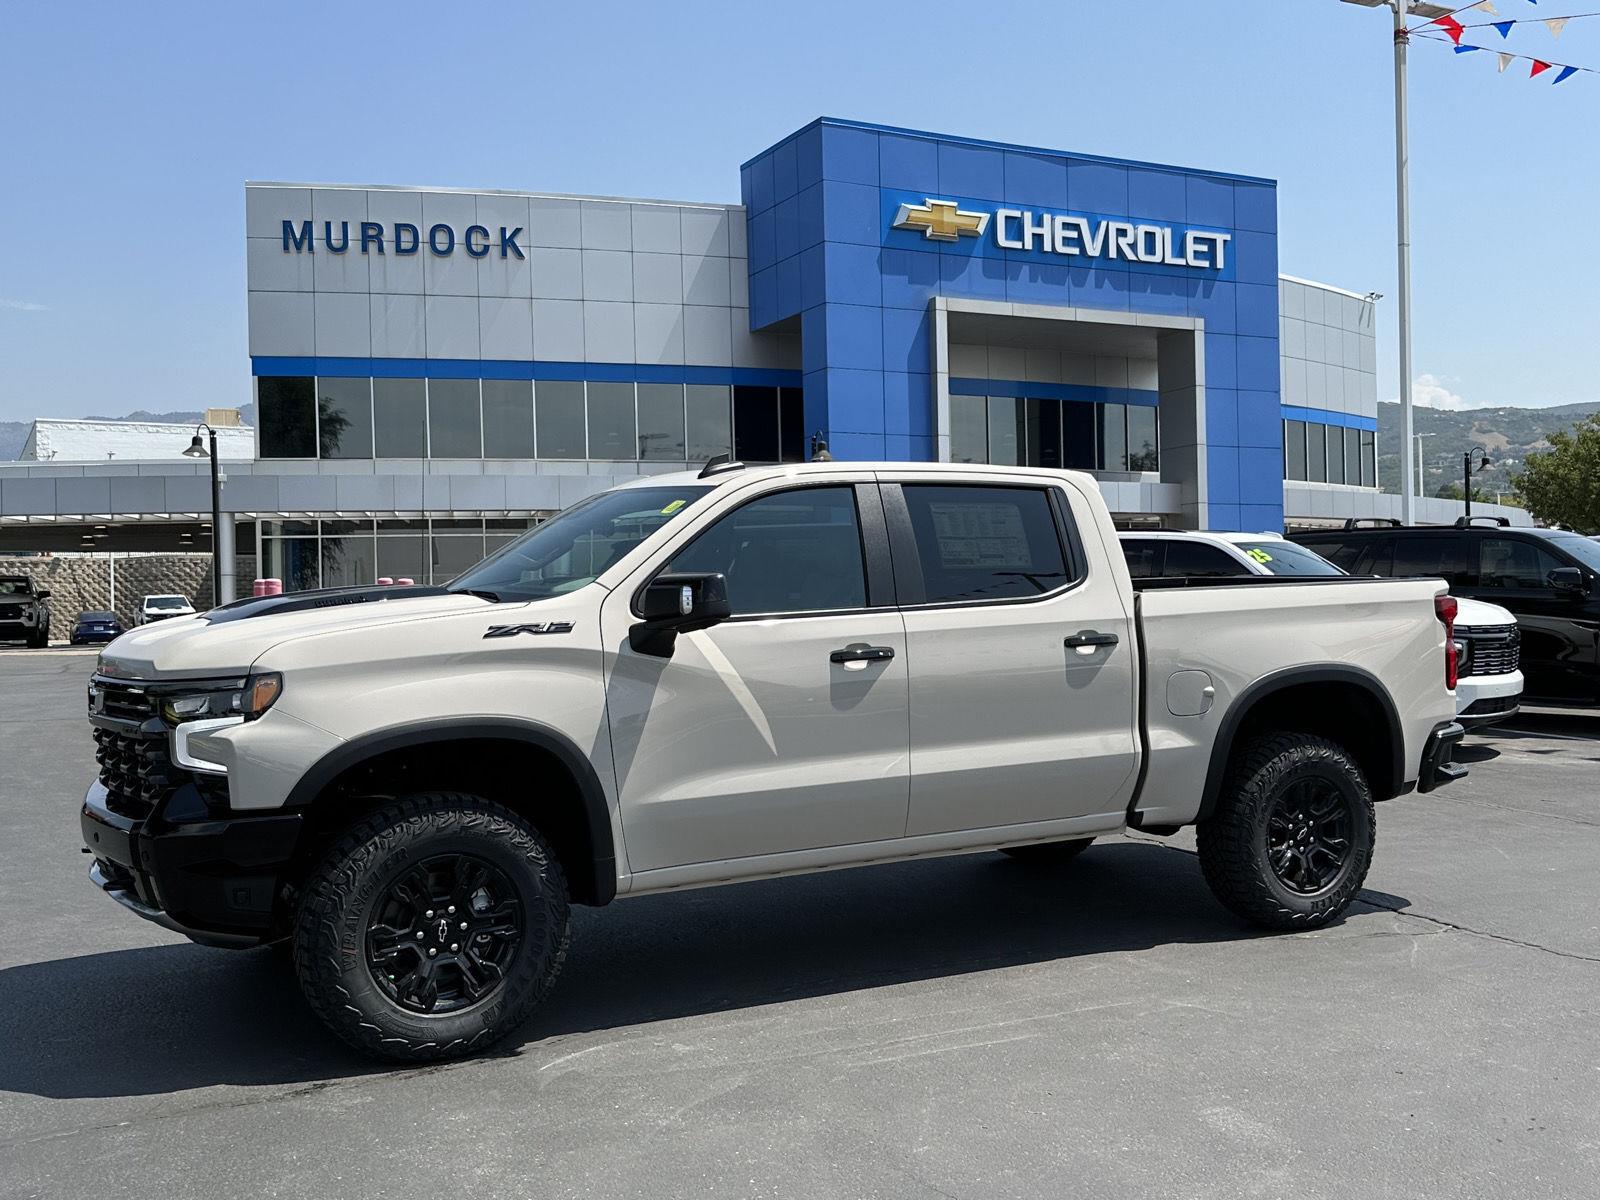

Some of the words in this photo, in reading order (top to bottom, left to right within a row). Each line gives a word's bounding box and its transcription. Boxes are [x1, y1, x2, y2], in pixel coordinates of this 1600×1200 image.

[282, 220, 526, 260] MURDOCK
[995, 208, 1231, 269] CHEVROLET
[482, 620, 577, 639] ZR2
